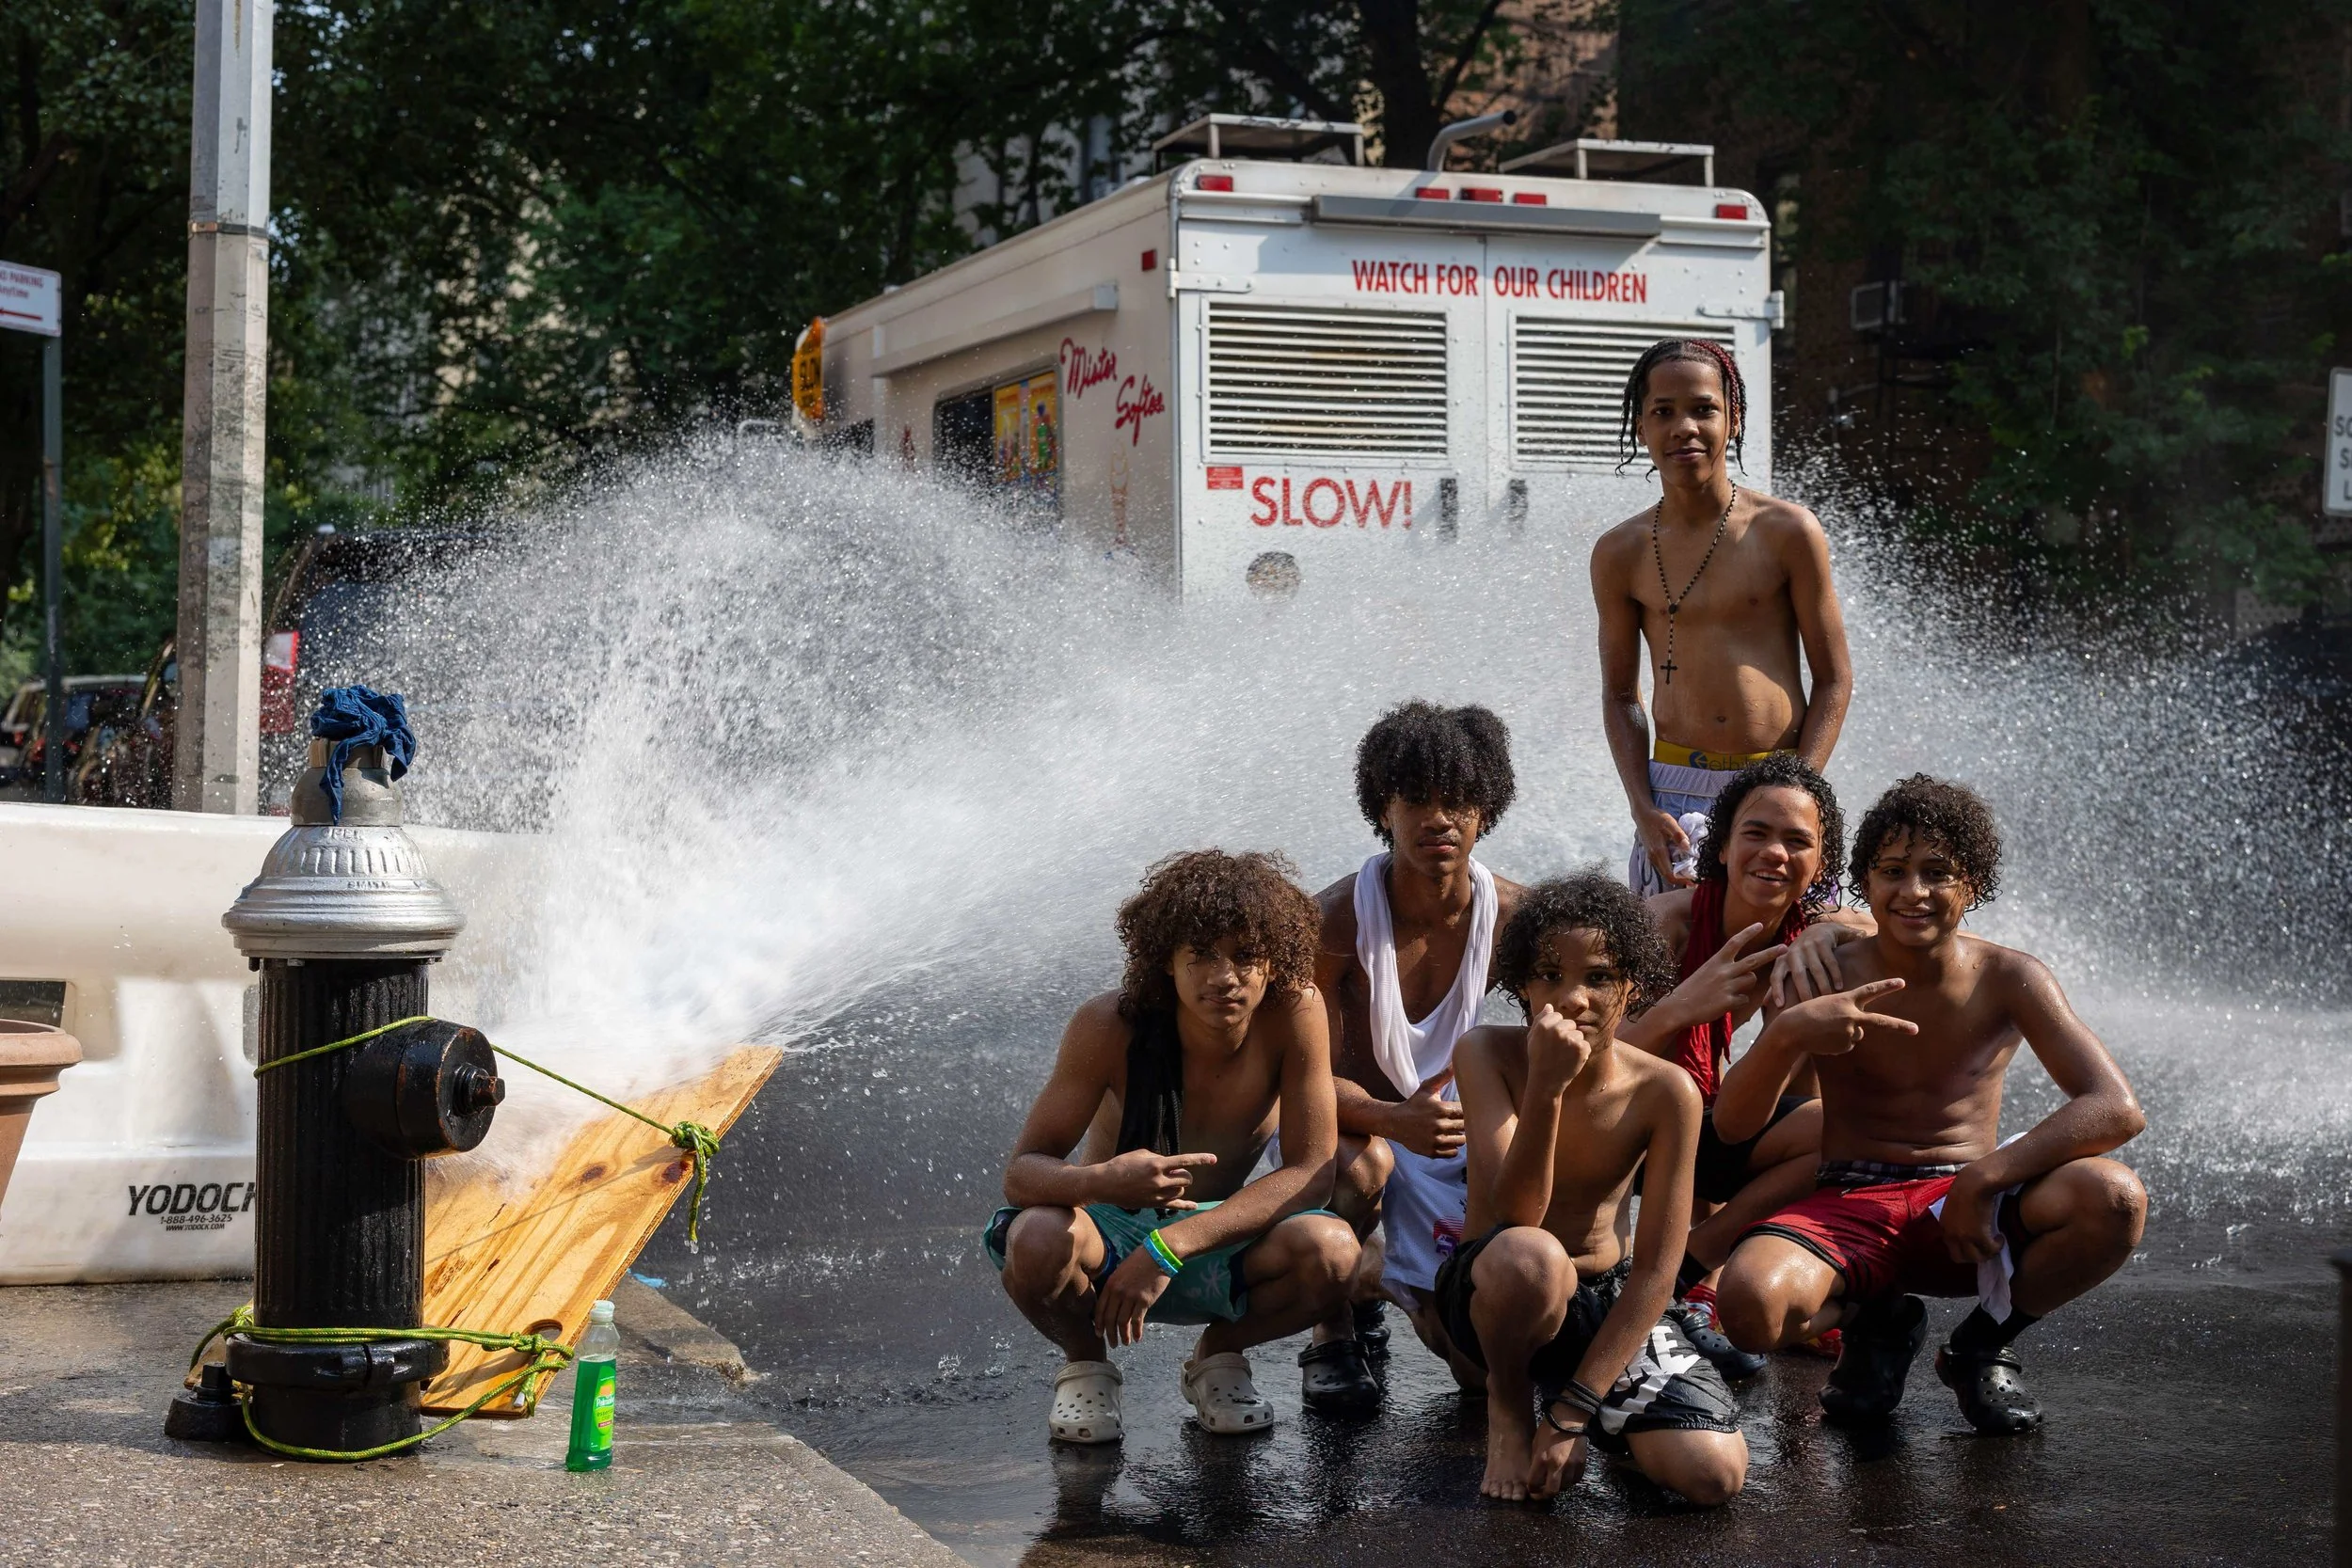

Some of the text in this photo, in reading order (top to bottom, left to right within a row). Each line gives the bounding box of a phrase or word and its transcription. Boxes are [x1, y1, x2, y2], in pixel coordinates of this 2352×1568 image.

[1352, 260, 1646, 304] WATCH FOR OUR CHILDREN
[1059, 337, 1118, 400] Mister
[1114, 373, 1166, 448] Softee
[1250, 476, 1412, 530] SLOW!
[160, 1213, 232, 1225] 1-888-496-3625
